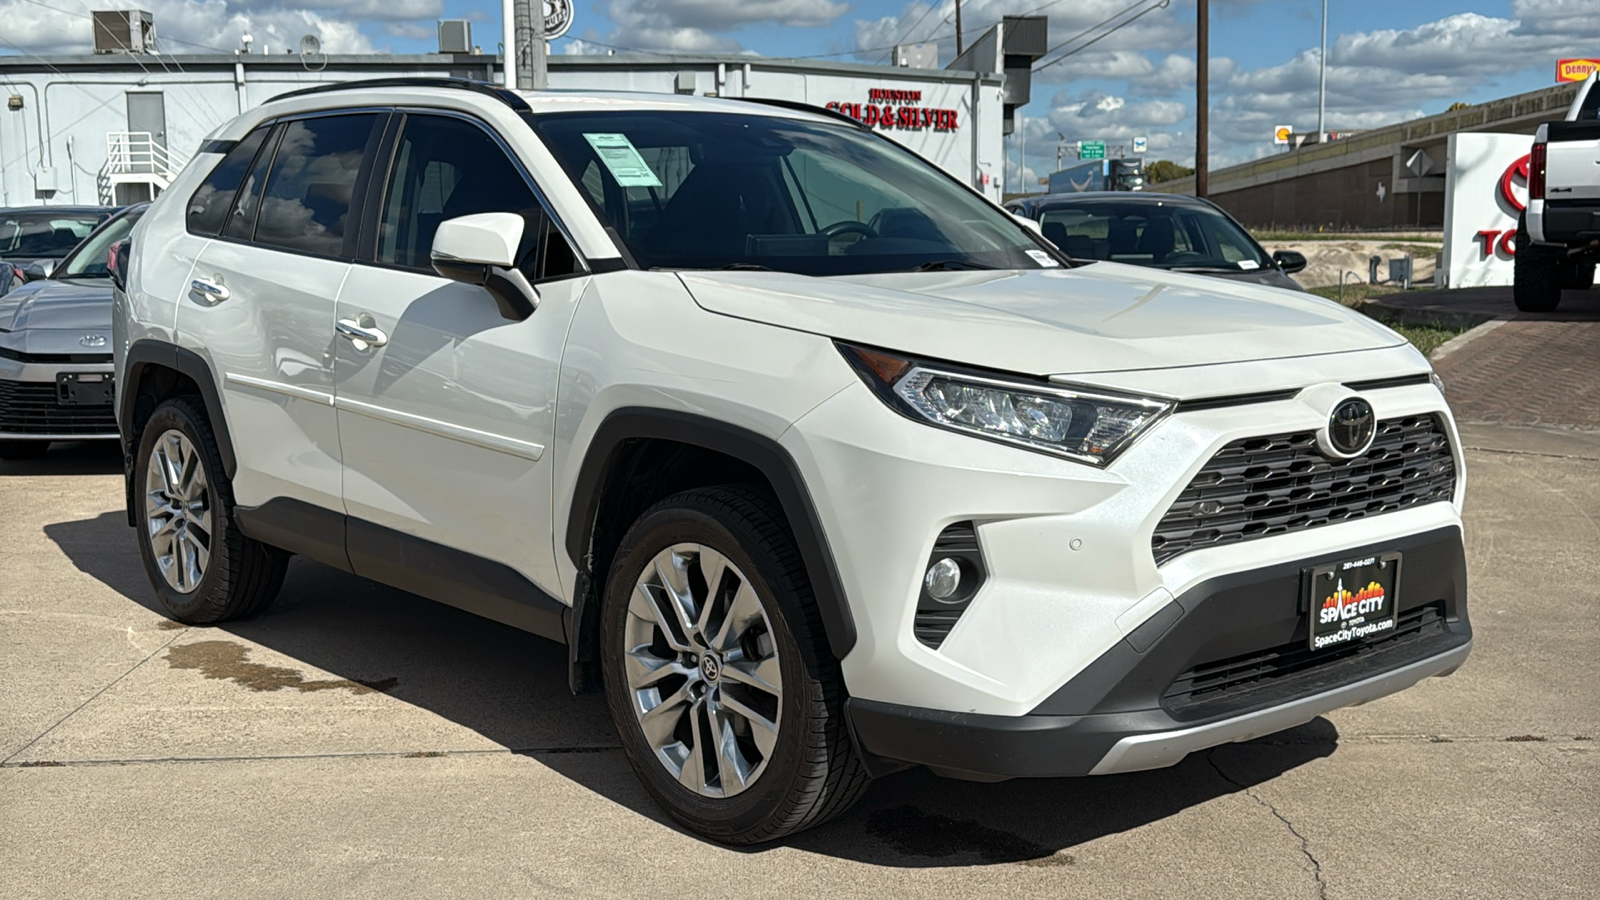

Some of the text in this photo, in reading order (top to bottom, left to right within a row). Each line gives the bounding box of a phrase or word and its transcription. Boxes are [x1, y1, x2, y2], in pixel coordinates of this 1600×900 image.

[1565, 64, 1597, 75] Denny's
[870, 88, 922, 101] HOUSTON
[898, 106, 959, 129] SILVER
[1320, 592, 1385, 624] SPACE CITY
[1348, 616, 1365, 626] TOYOTA
[1314, 619, 1394, 648] SpaceCityToyota.com
